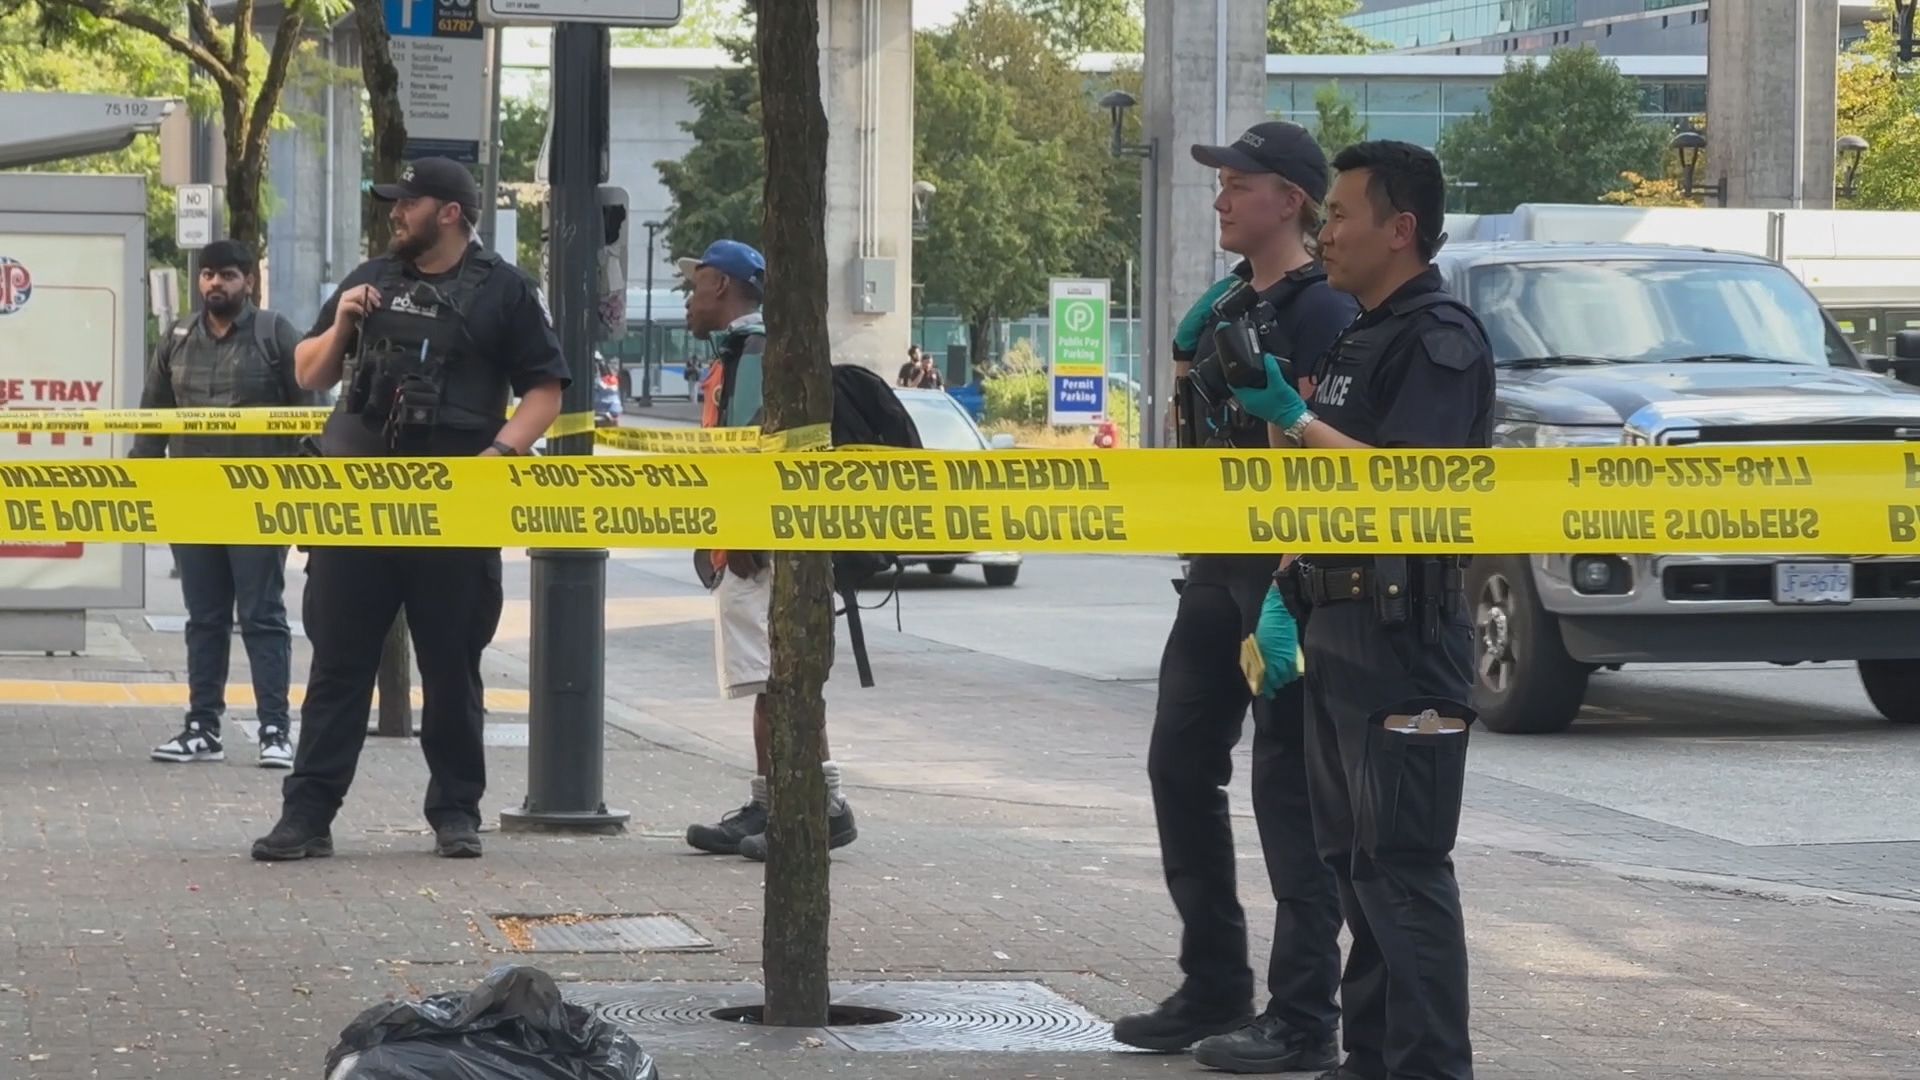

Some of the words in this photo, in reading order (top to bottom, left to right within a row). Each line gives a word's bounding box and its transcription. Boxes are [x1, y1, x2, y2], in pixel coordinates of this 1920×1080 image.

[438, 19, 474, 32] 61787
[411, 53, 432, 61] Scott
[433, 54, 453, 63] Road
[411, 63, 439, 71] Station
[410, 82, 427, 90] New
[428, 83, 448, 91] West
[410, 91, 437, 100] Station
[105, 103, 148, 116] 75192
[409, 110, 450, 119] Scottsdale
[186, 193, 201, 205] NO
[1058, 336, 1083, 347] Public
[1085, 337, 1099, 349] Pay
[1063, 349, 1095, 361] Parking
[1063, 378, 1094, 390] Permit
[30, 379, 103, 402] TRAY
[1315, 375, 1352, 406] OLICE
[1060, 390, 1097, 404] Parking
